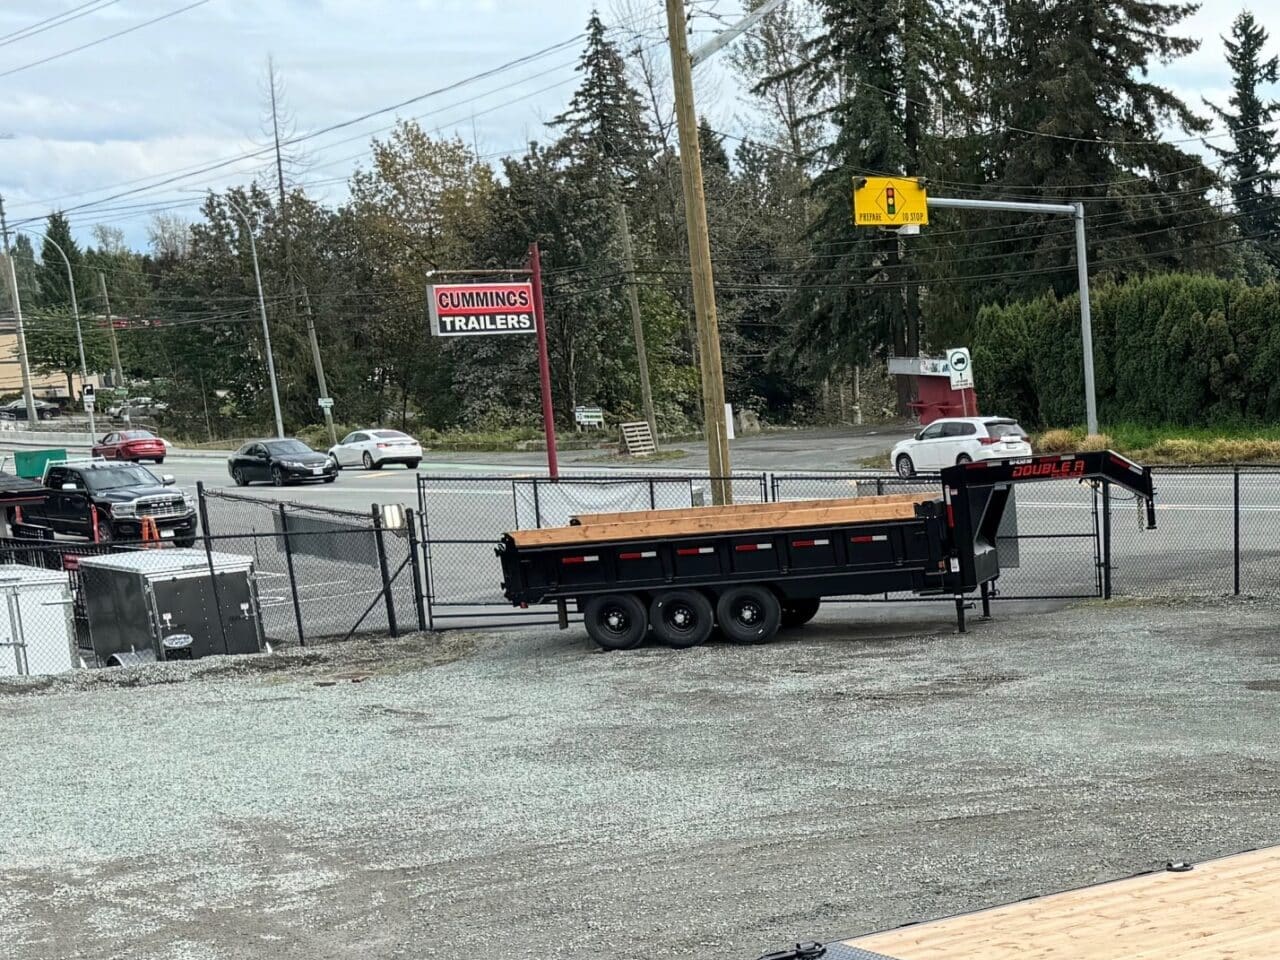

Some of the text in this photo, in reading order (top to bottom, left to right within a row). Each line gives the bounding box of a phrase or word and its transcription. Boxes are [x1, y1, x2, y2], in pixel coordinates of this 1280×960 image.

[910, 212, 924, 221] STOP
[438, 291, 529, 309] CUMMINGS
[442, 314, 530, 331] TRAILERS
[1012, 461, 1071, 477] DOUBLE
[1074, 459, 1085, 471] A
